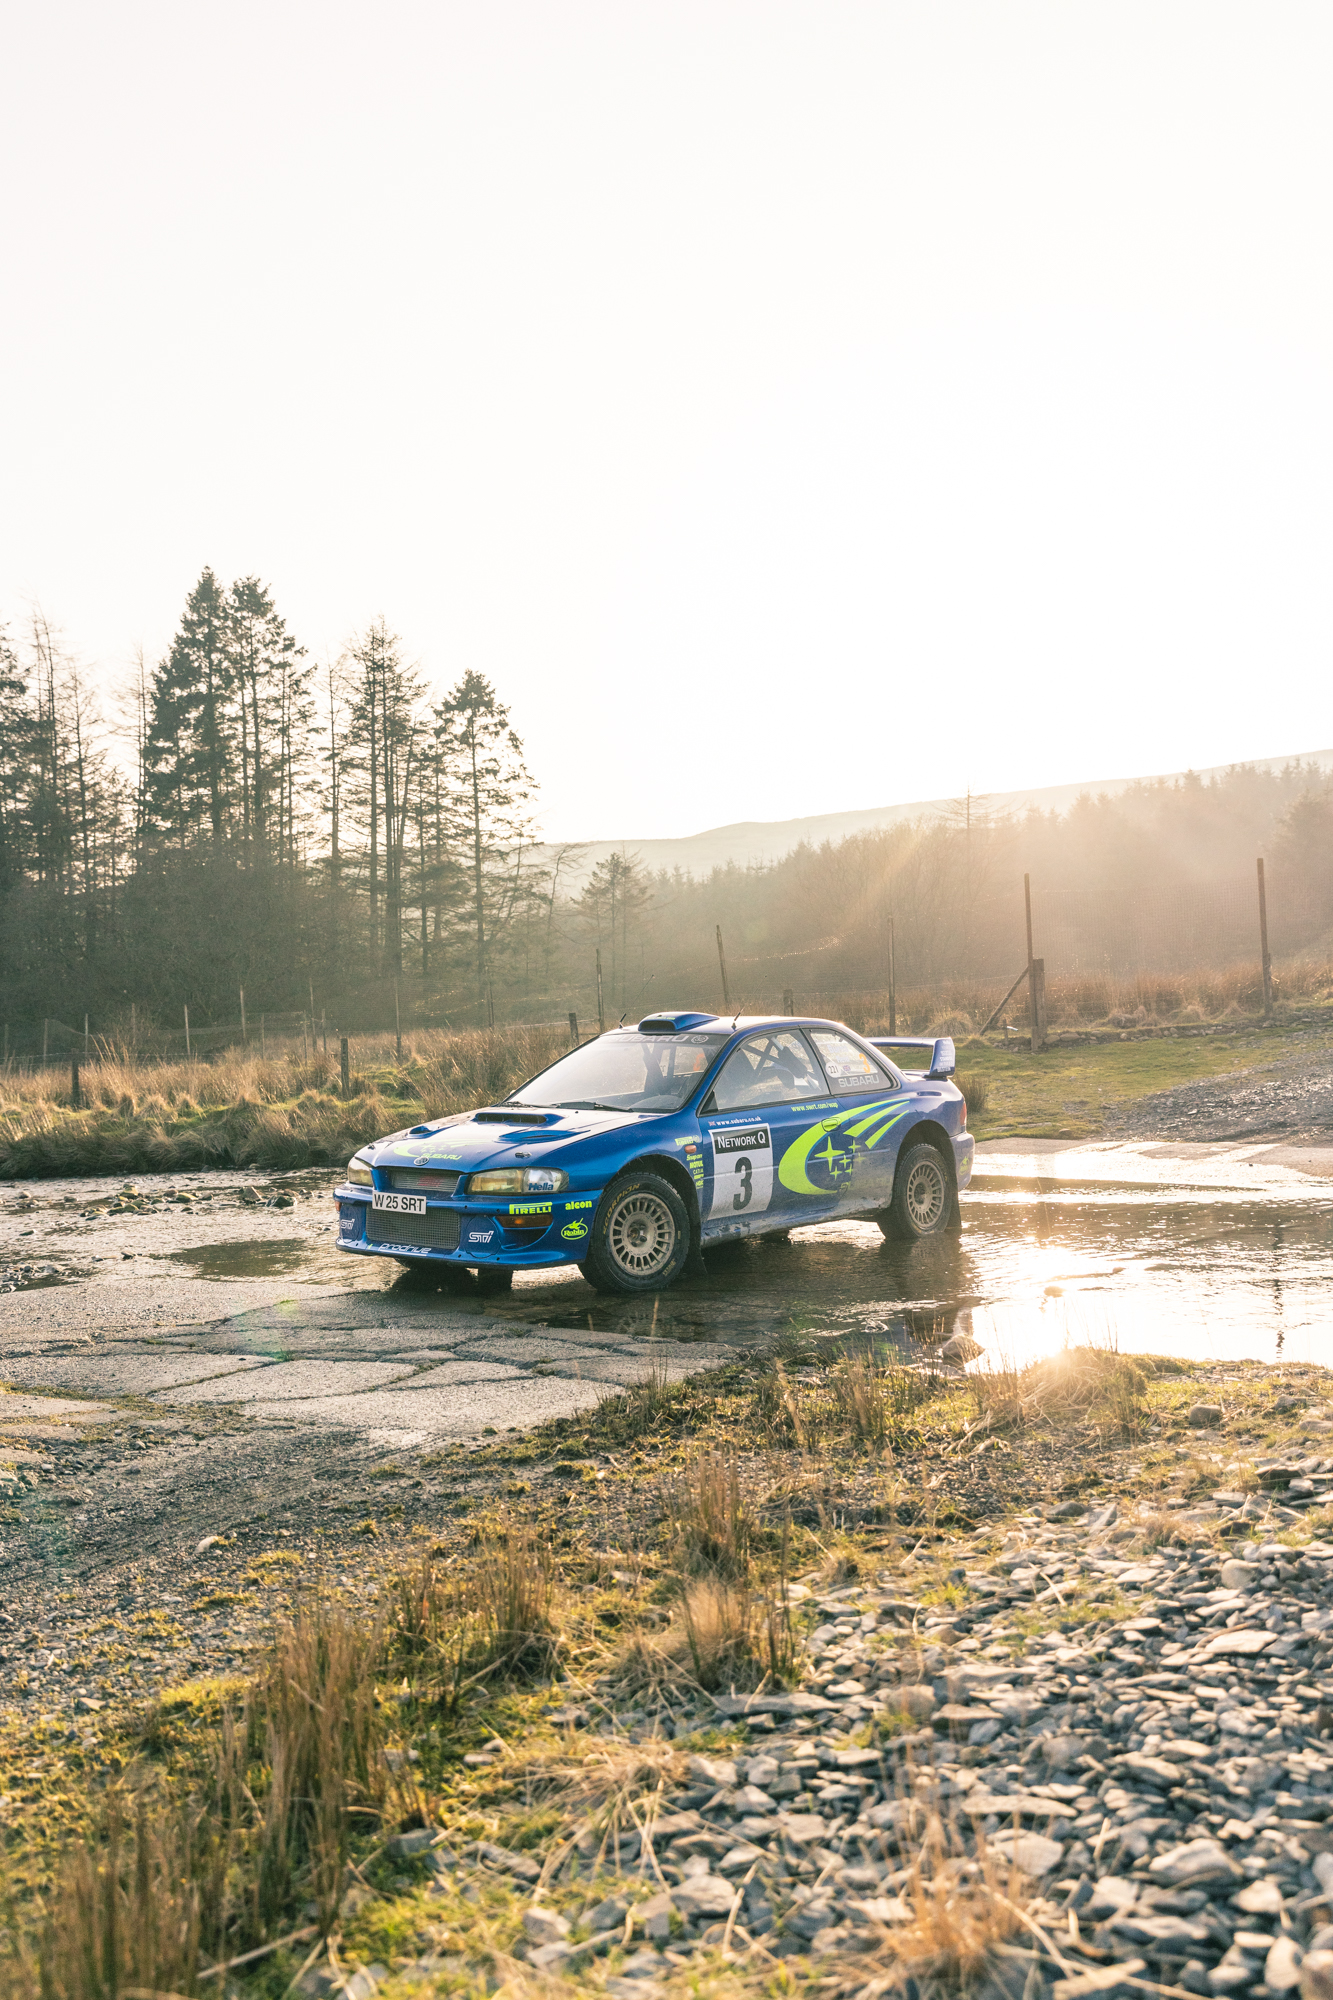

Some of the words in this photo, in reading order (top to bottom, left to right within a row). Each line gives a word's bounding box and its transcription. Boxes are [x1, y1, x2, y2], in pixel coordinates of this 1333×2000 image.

[859, 1053, 871, 1073] 3
[838, 1075, 880, 1088] SUBARU
[716, 1116, 762, 1126] www.subaru.co.uk
[717, 1135, 757, 1148] NETWORK
[757, 1131, 766, 1144] Q
[421, 1152, 463, 1160] SUBARU
[528, 1182, 554, 1191] Hella
[733, 1156, 752, 1210] 3
[374, 1194, 384, 1208] W
[385, 1195, 398, 1209] 25
[400, 1197, 424, 1212] SRT
[509, 1202, 552, 1214] PIRELLI
[565, 1200, 592, 1210] alcon
[564, 1229, 585, 1237] Robin
[378, 1243, 432, 1253] prodrive
